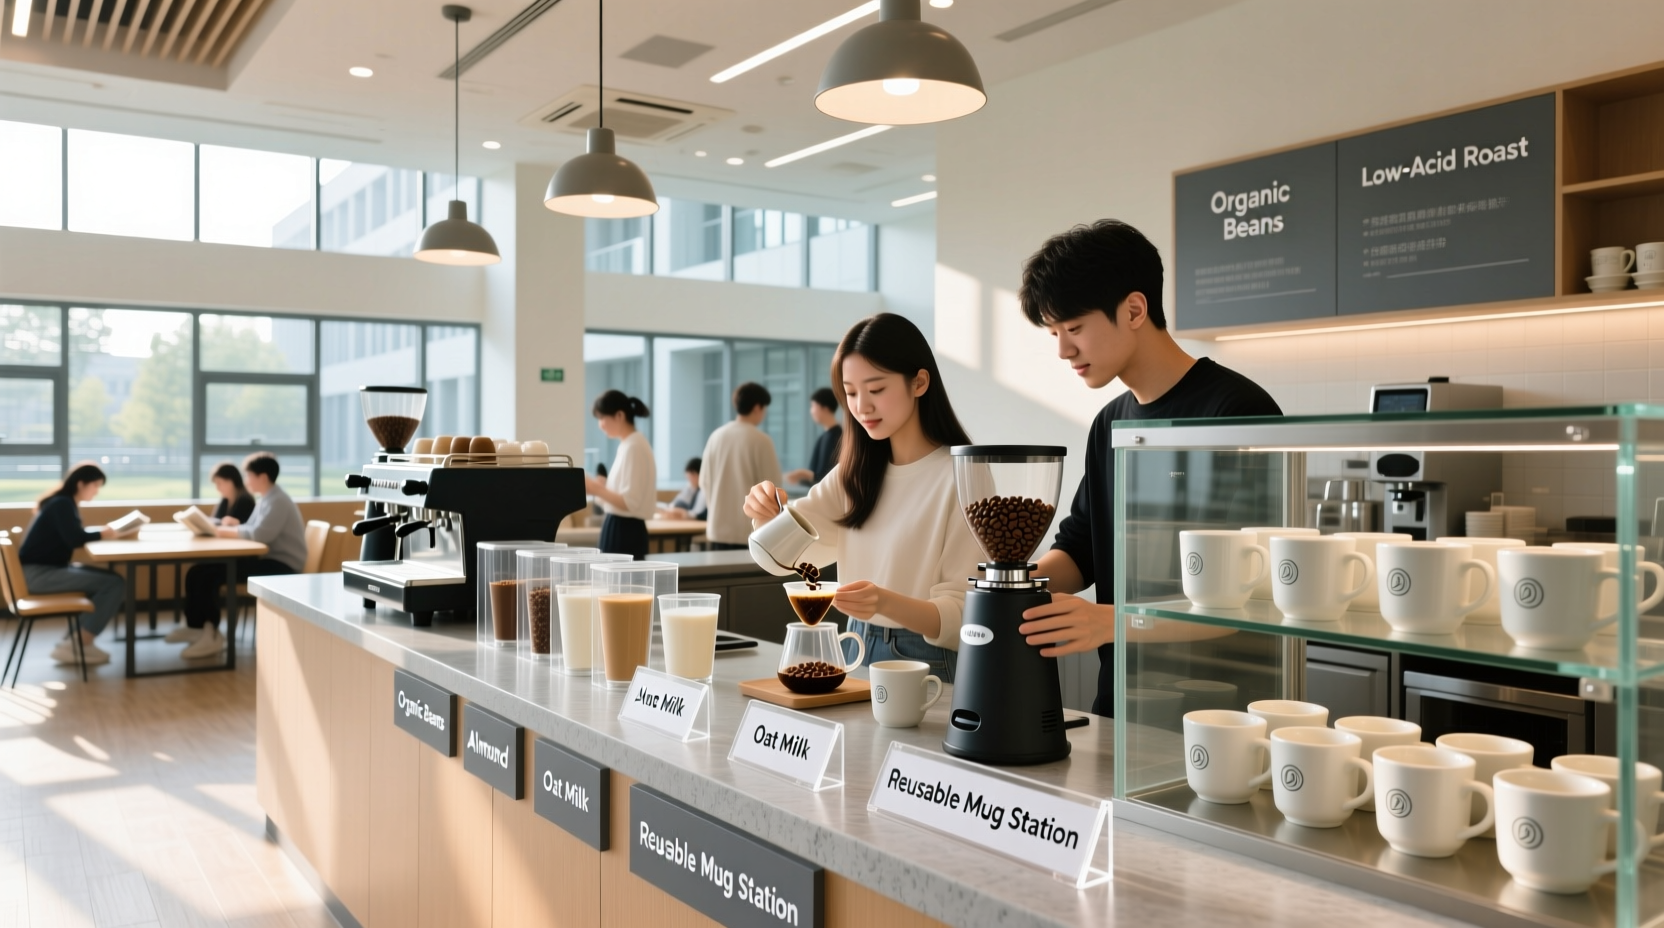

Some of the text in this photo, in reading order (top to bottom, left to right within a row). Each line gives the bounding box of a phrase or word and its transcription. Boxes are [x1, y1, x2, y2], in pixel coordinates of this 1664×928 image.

[1361, 136, 1530, 187] Low-Acid Roast
[1210, 180, 1291, 217] Organic
[1223, 213, 1285, 241] Beans
[753, 724, 811, 761] Oat Milk
[543, 770, 590, 812] Oat Milk
[887, 768, 1079, 849] Reusable Mug Station
[700, 851, 734, 899] Mug
[737, 872, 799, 927] Station
